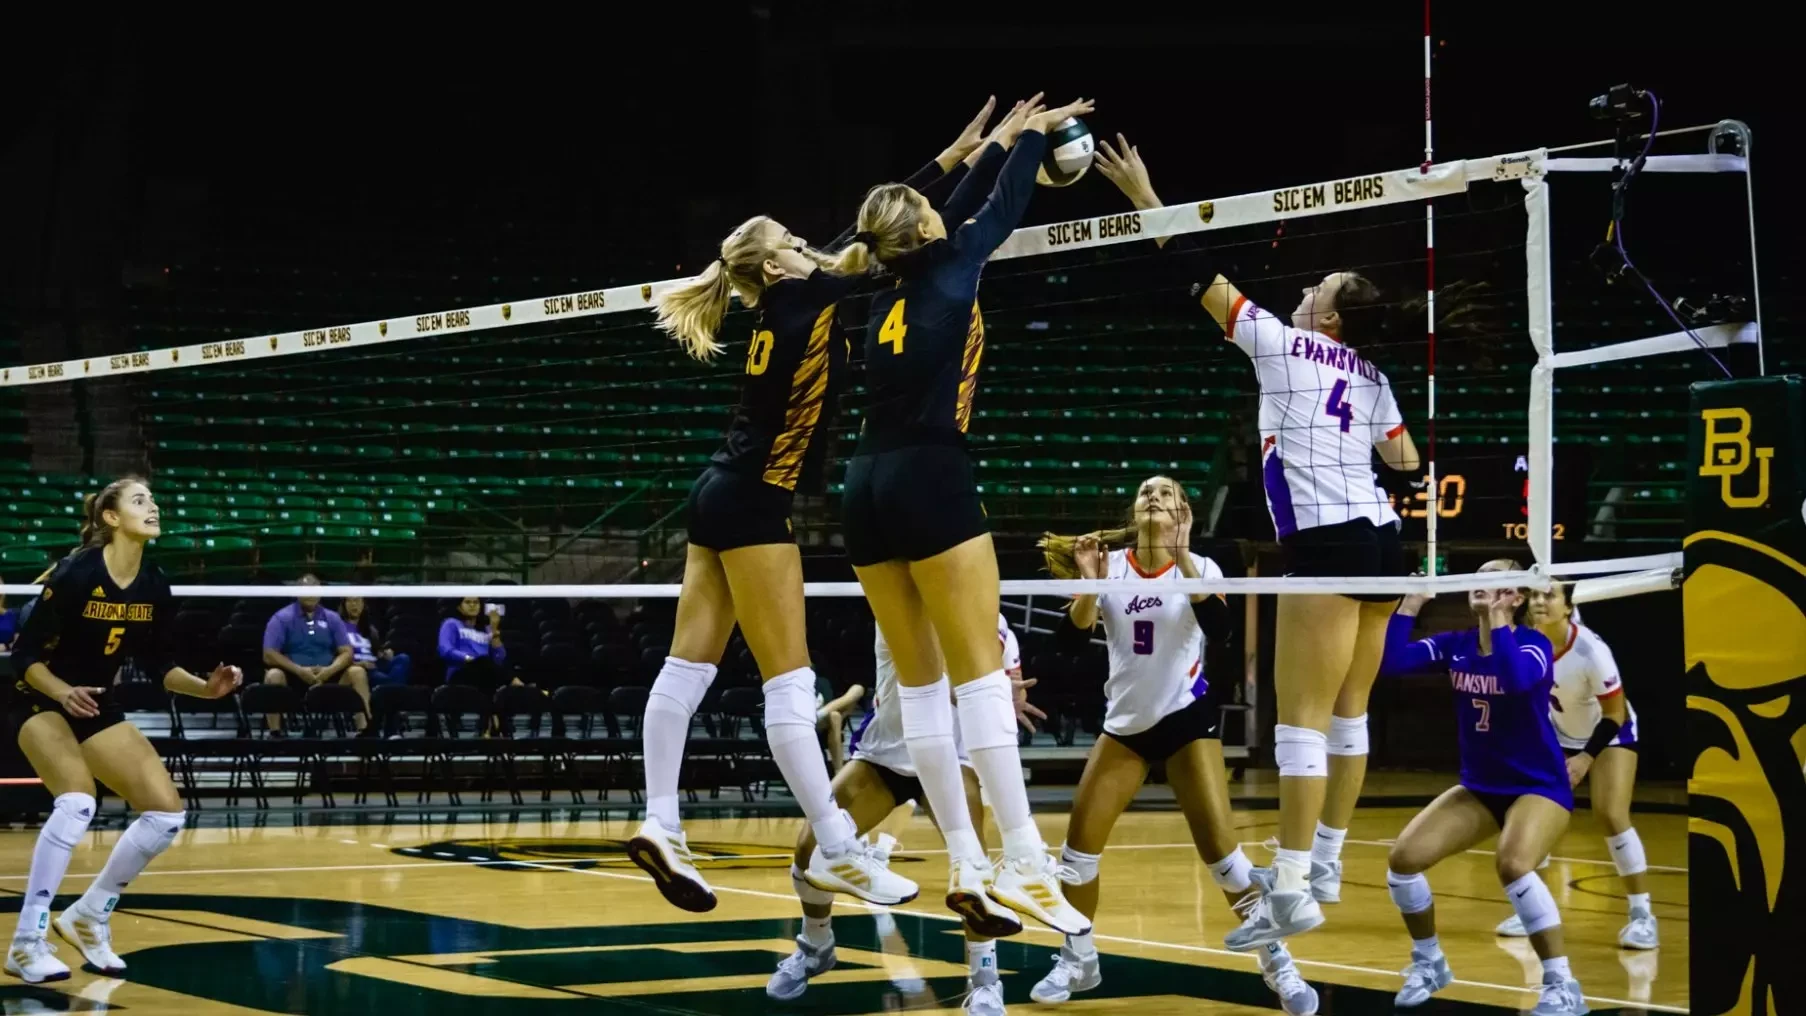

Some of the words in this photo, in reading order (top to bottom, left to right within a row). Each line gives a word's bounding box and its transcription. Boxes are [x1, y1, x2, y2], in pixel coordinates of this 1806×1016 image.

[1334, 176, 1384, 204] BEARS
[1099, 213, 1141, 238] BEARS
[577, 291, 605, 311] BEARS
[446, 310, 470, 328] BEARS
[878, 299, 908, 355] 4
[329, 326, 351, 343] BEARS
[132, 352, 150, 367] BEARS
[225, 340, 245, 356] BEARS
[746, 329, 774, 375] 0
[47, 363, 64, 377] BEARS
[1326, 378, 1353, 432] 4
[1699, 408, 1774, 508] BU
[1552, 523, 1566, 540] 2
[82, 600, 126, 621] ARIZONA
[127, 603, 153, 621] STATE
[1125, 595, 1163, 615] Aces
[103, 627, 126, 655] 5
[1133, 620, 1154, 655] 9
[1471, 698, 1490, 731] 7
